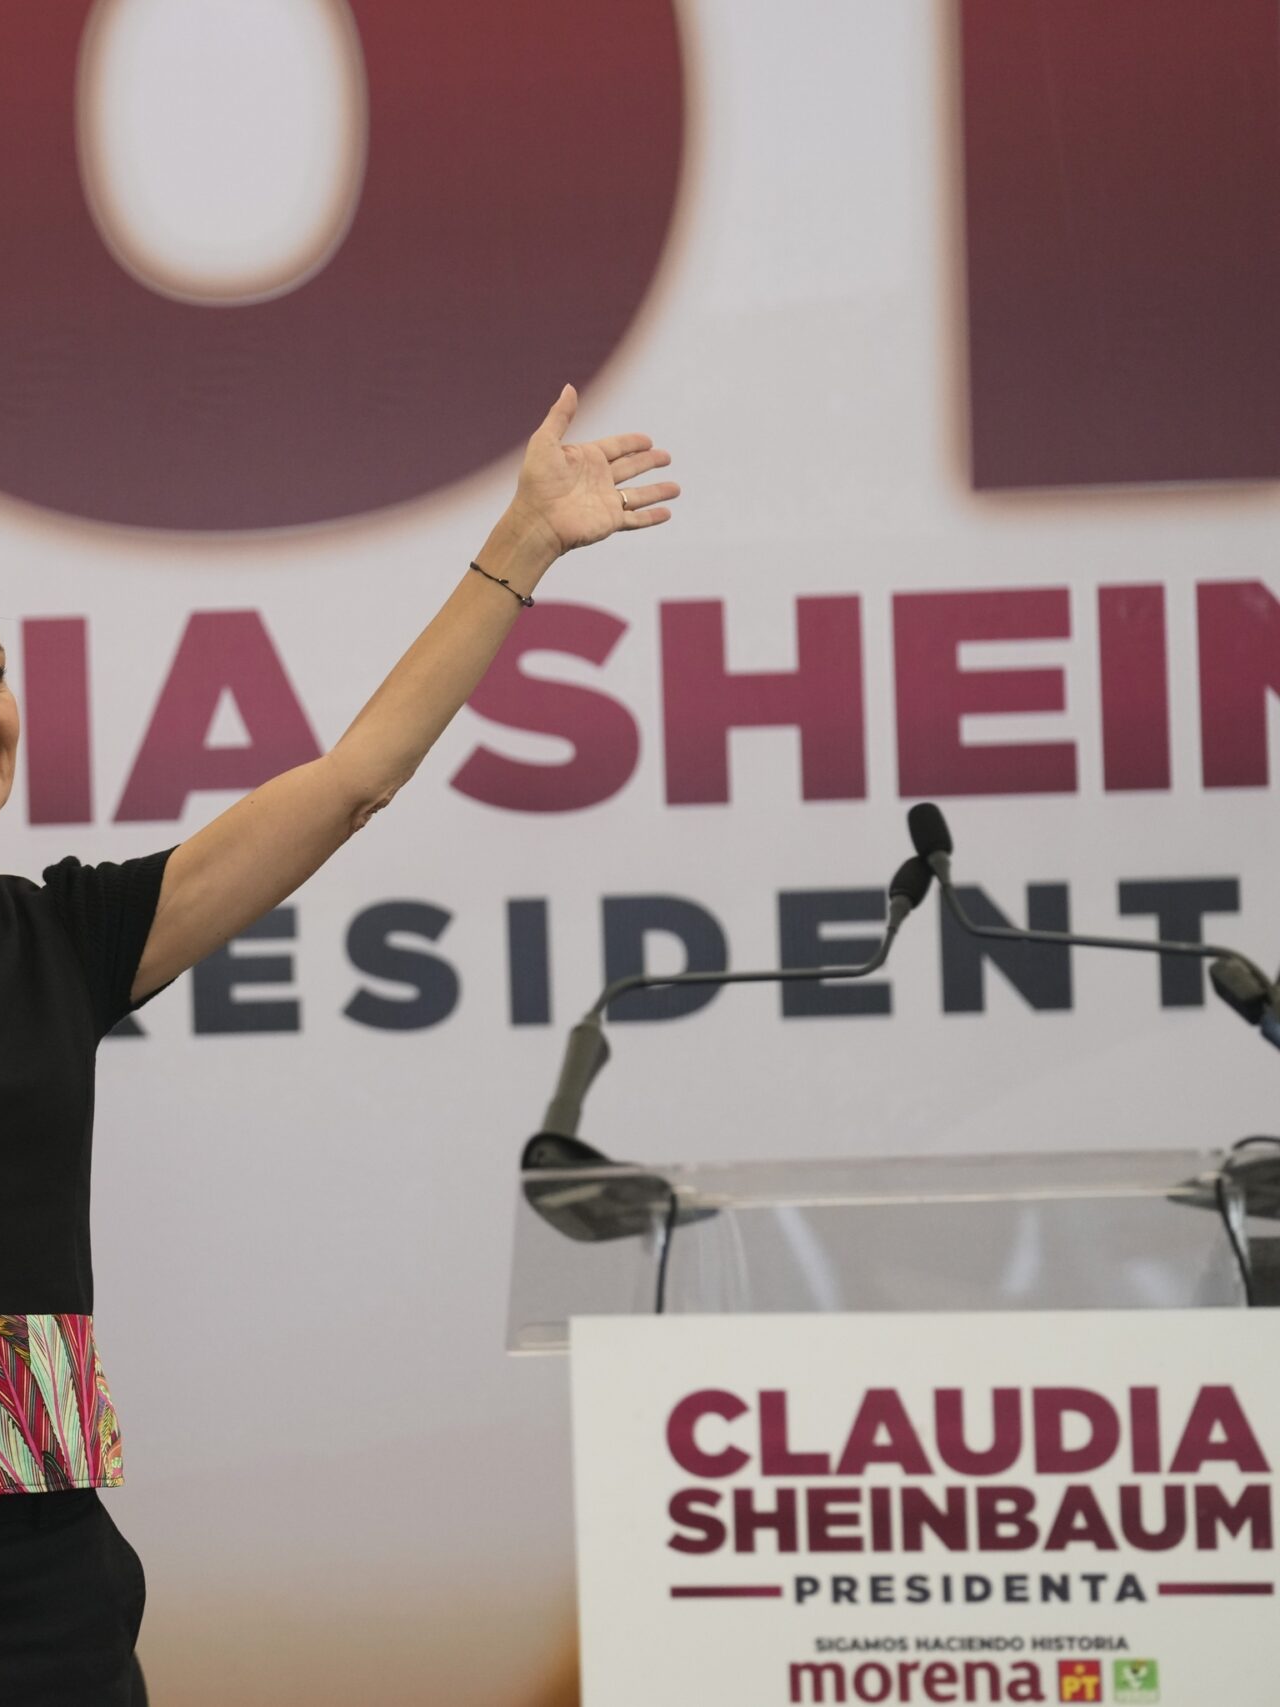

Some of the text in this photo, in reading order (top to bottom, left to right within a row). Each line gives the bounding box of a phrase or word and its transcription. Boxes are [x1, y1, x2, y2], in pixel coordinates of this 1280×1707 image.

[96, 876, 1241, 1041] ESIDENT
[666, 1385, 1272, 1479] CLAUDIA
[667, 1484, 1274, 1555] SHEINBAUM
[794, 1573, 1147, 1605] PRESIDENTA
[814, 1635, 1130, 1653] SIGAMOS HACIENDO HISTORIA
[789, 1659, 1046, 1703] morena
[1061, 1675, 1099, 1701] PT
